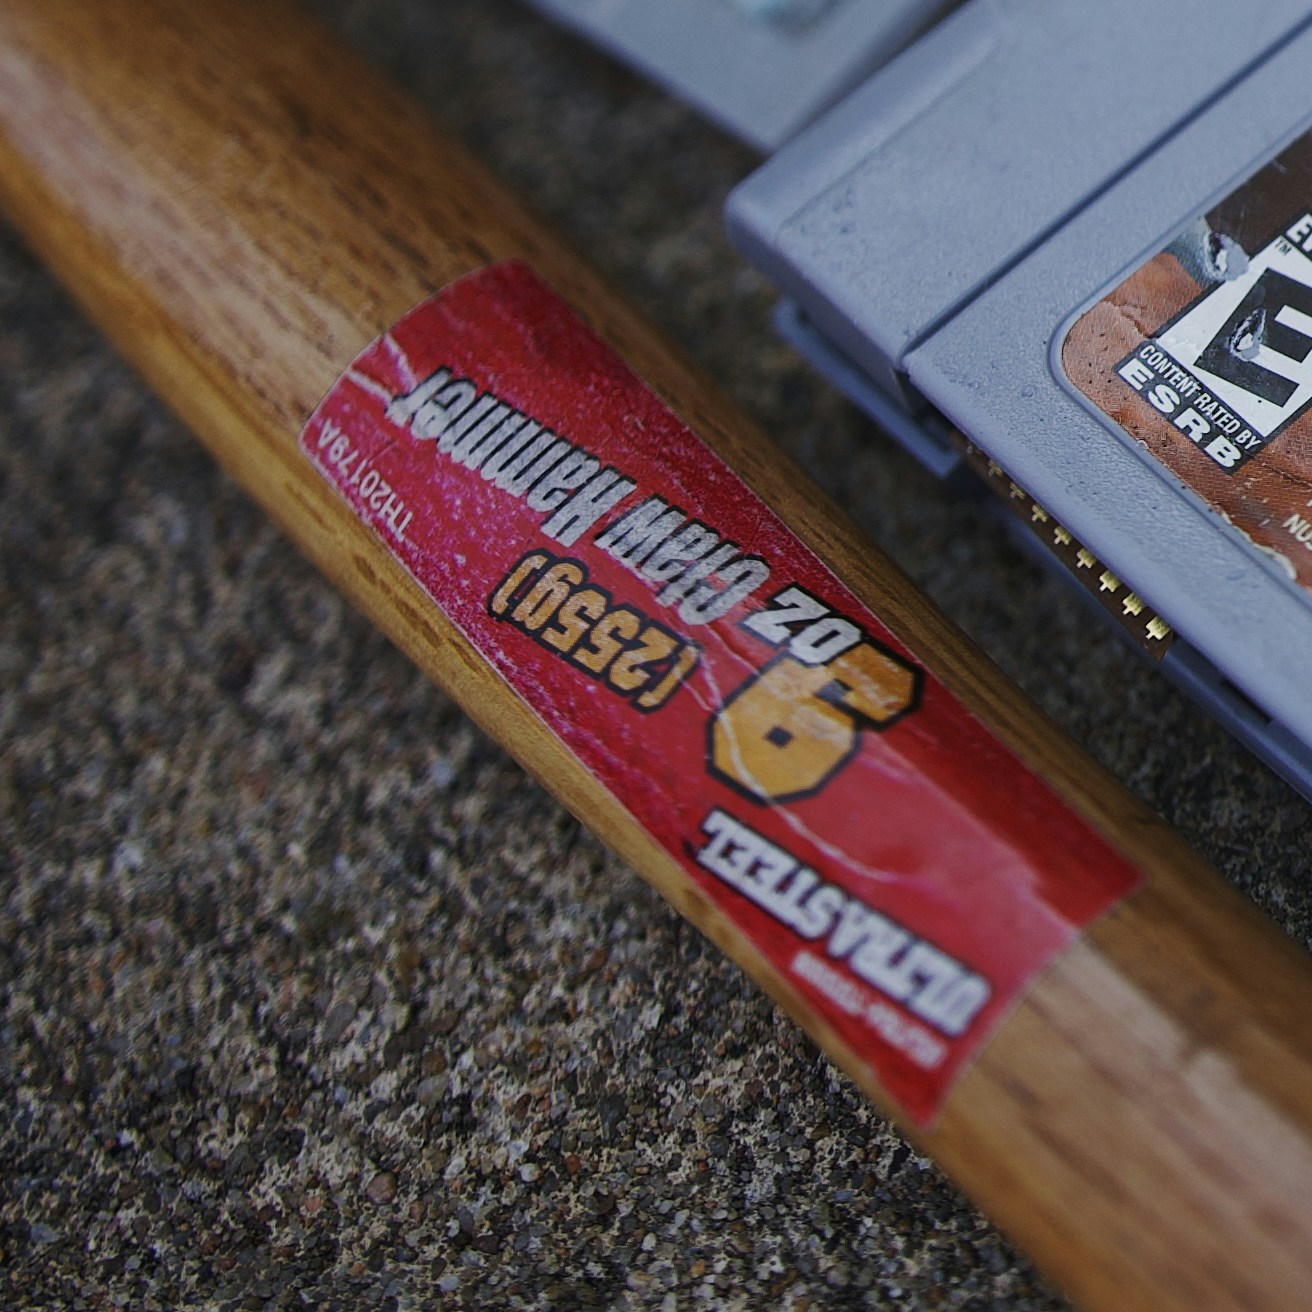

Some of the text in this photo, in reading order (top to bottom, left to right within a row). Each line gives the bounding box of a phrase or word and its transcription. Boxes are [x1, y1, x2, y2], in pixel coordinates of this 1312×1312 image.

[1116, 357, 1243, 470] ESRB
[1139, 343, 1262, 451] CONTENT RATED BY
[319, 418, 414, 544] TH20179A
[384, 364, 772, 628] Claw Hammer
[488, 548, 702, 714] (255g)
[705, 641, 924, 804] 9
